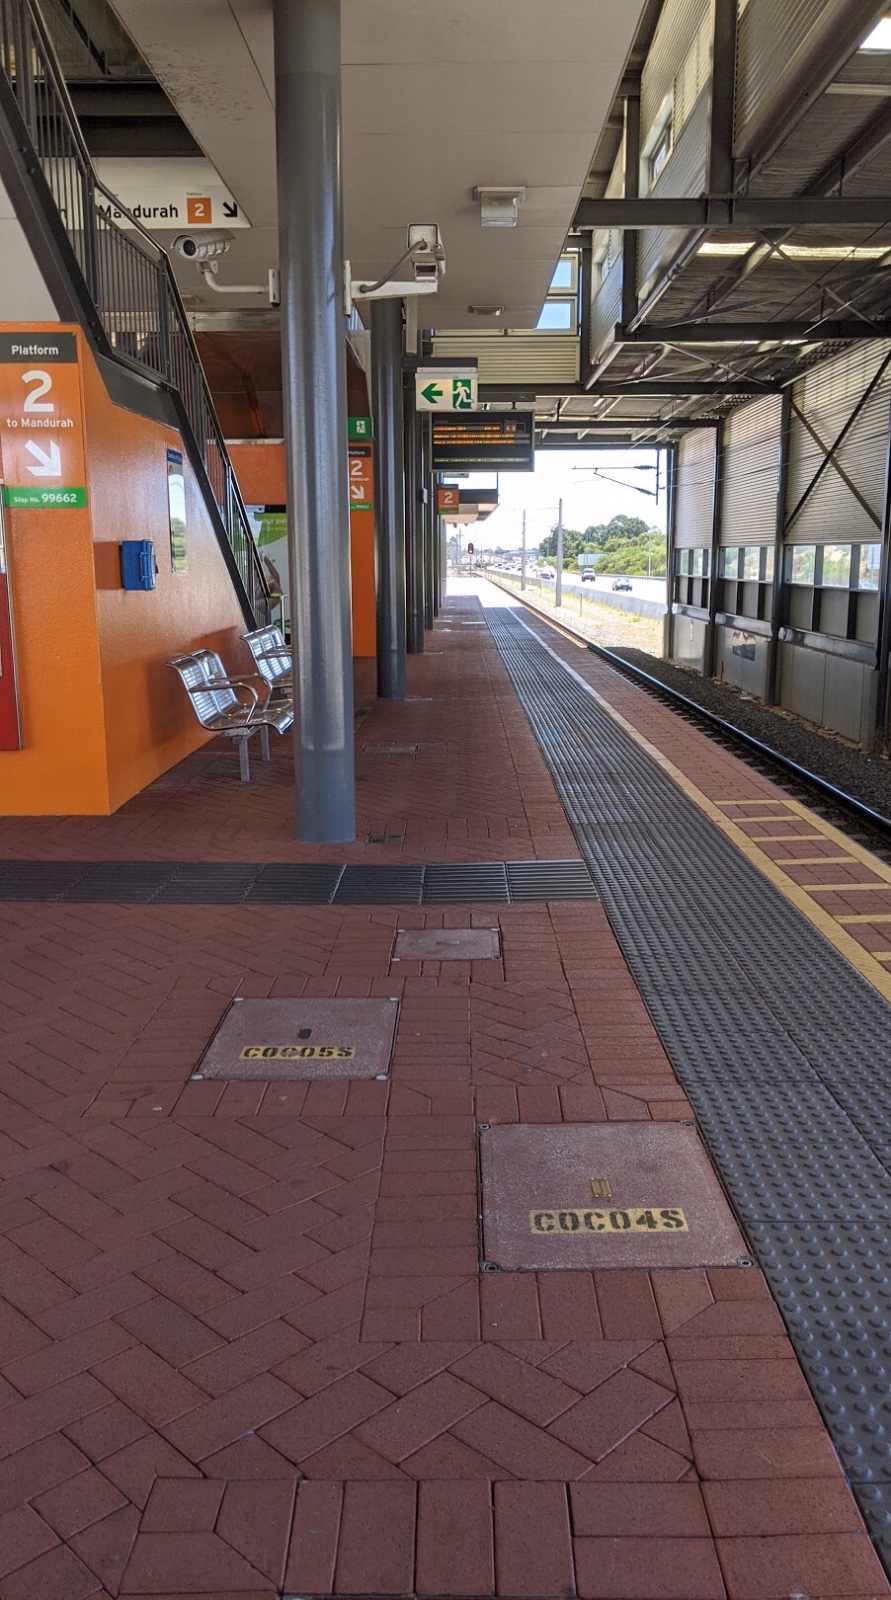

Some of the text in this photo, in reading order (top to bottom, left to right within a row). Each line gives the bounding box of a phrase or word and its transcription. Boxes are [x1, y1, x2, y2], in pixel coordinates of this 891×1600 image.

[99, 203, 179, 218] Madurah
[194, 203, 205, 217] 2
[11, 344, 59, 355] Platform
[21, 369, 55, 412] 2
[6, 417, 74, 428] to Mandurah
[350, 459, 363, 476] 2
[13, 496, 29, 504] Stop
[41, 493, 78, 503] 99662
[444, 491, 453, 504] 2
